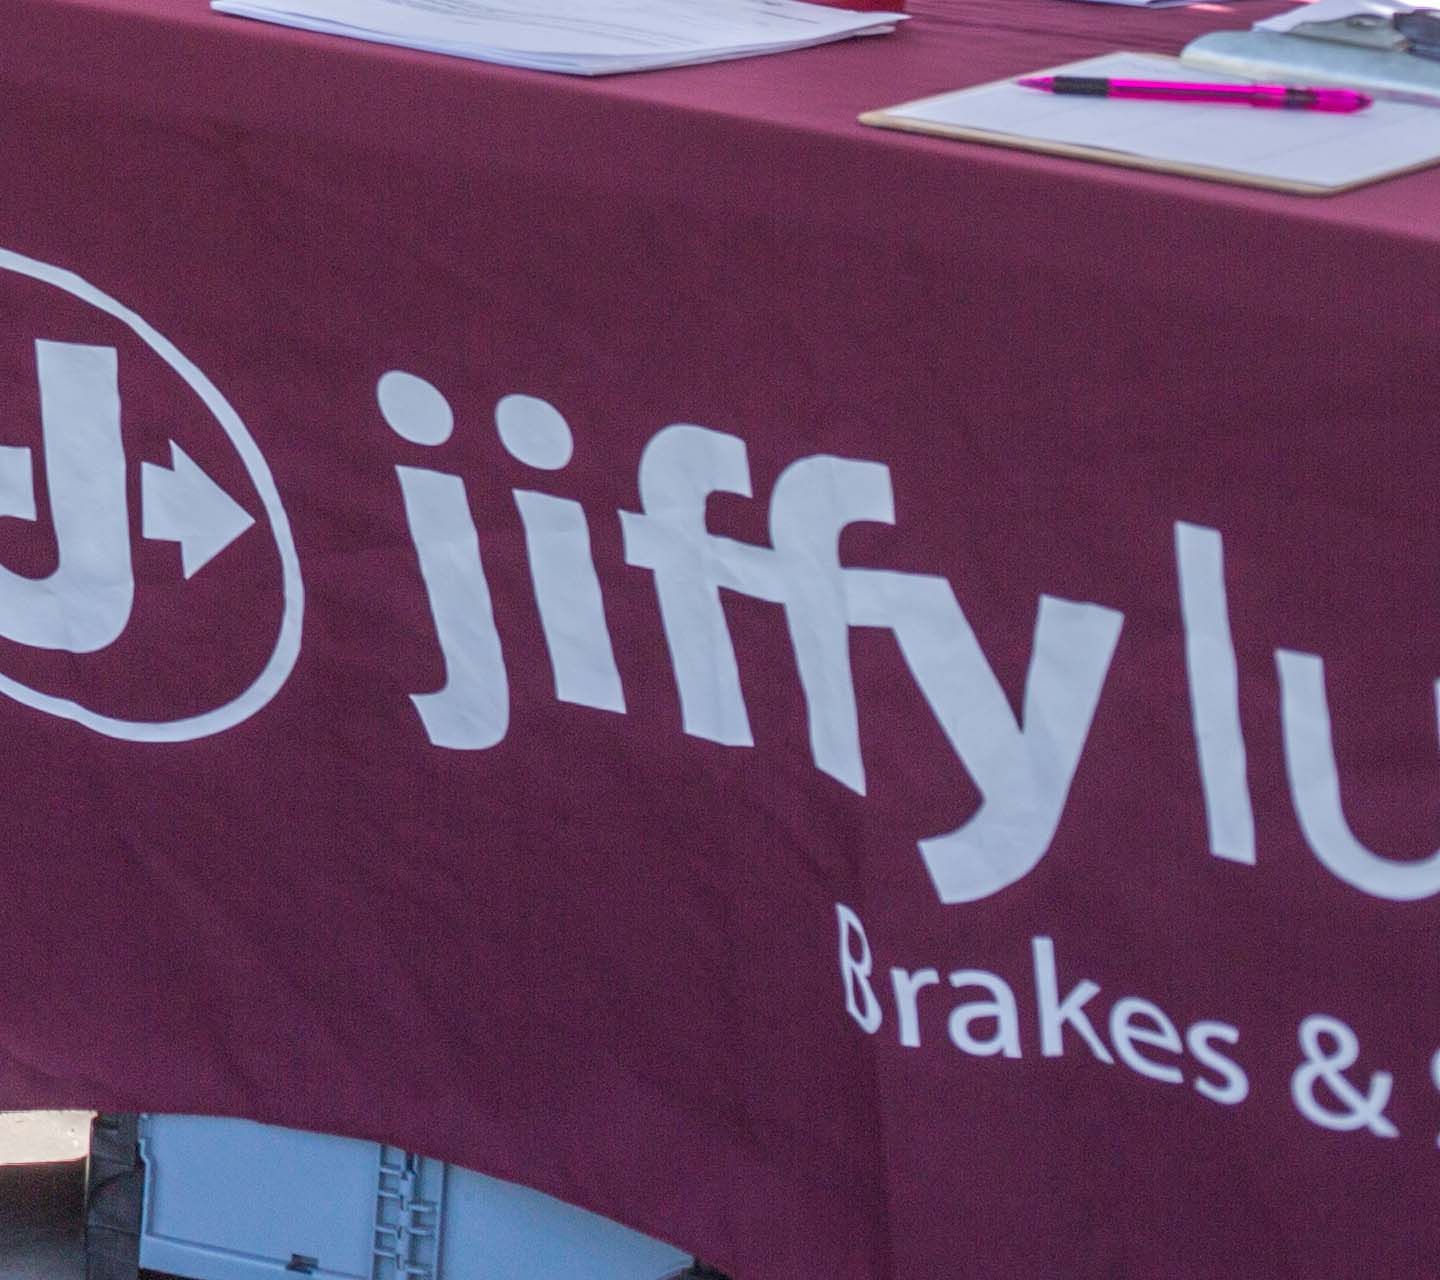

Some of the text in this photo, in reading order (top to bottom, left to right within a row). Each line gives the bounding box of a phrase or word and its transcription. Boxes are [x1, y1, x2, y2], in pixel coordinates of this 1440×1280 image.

[377, 371, 1440, 905] jiffy lu
[836, 903, 1250, 1106] Brakes
[1290, 1013, 1400, 1139] &
